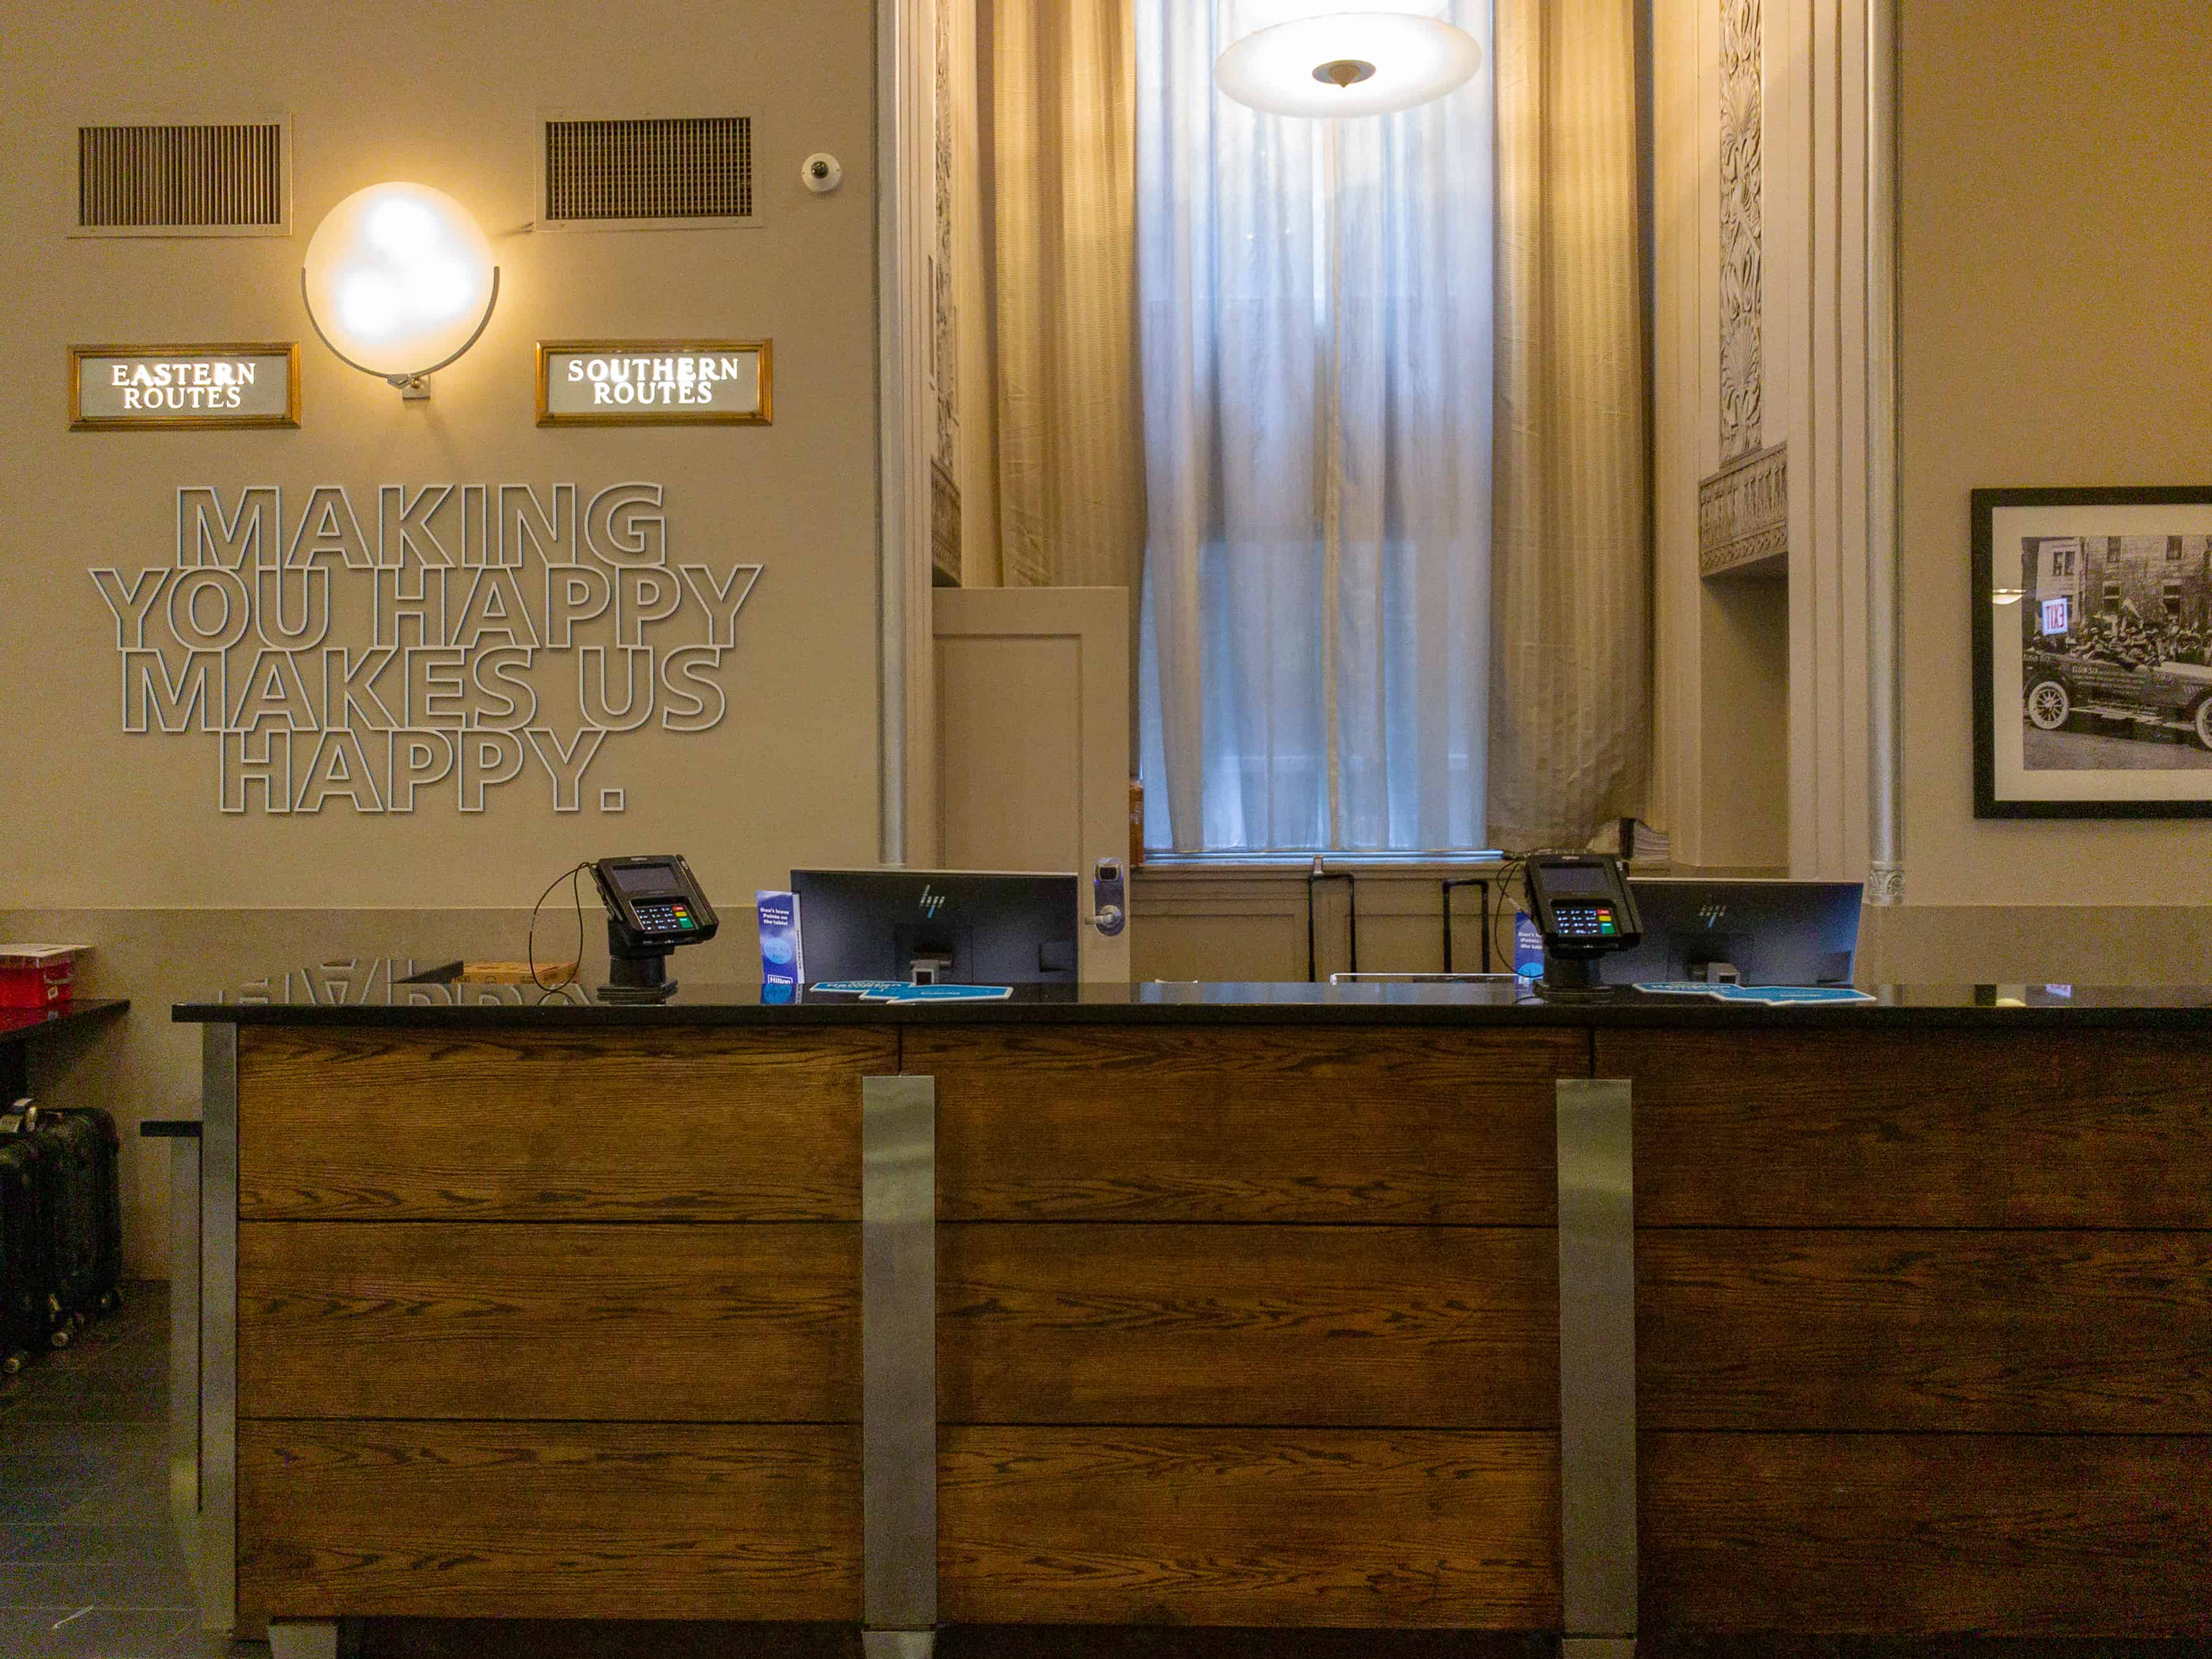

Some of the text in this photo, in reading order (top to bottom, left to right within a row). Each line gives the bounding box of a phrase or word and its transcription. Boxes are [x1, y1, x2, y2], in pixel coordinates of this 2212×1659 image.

[111, 363, 255, 386] EASTERN
[568, 357, 738, 382] SOUTHERN
[123, 386, 241, 409] ROUTES
[594, 382, 712, 404] ROUTES
[176, 482, 666, 571] MAKING
[88, 564, 762, 651] YOU HAPPY
[121, 645, 726, 732] MAKES US
[219, 727, 625, 813] HAPPY.
[920, 884, 945, 918] hp
